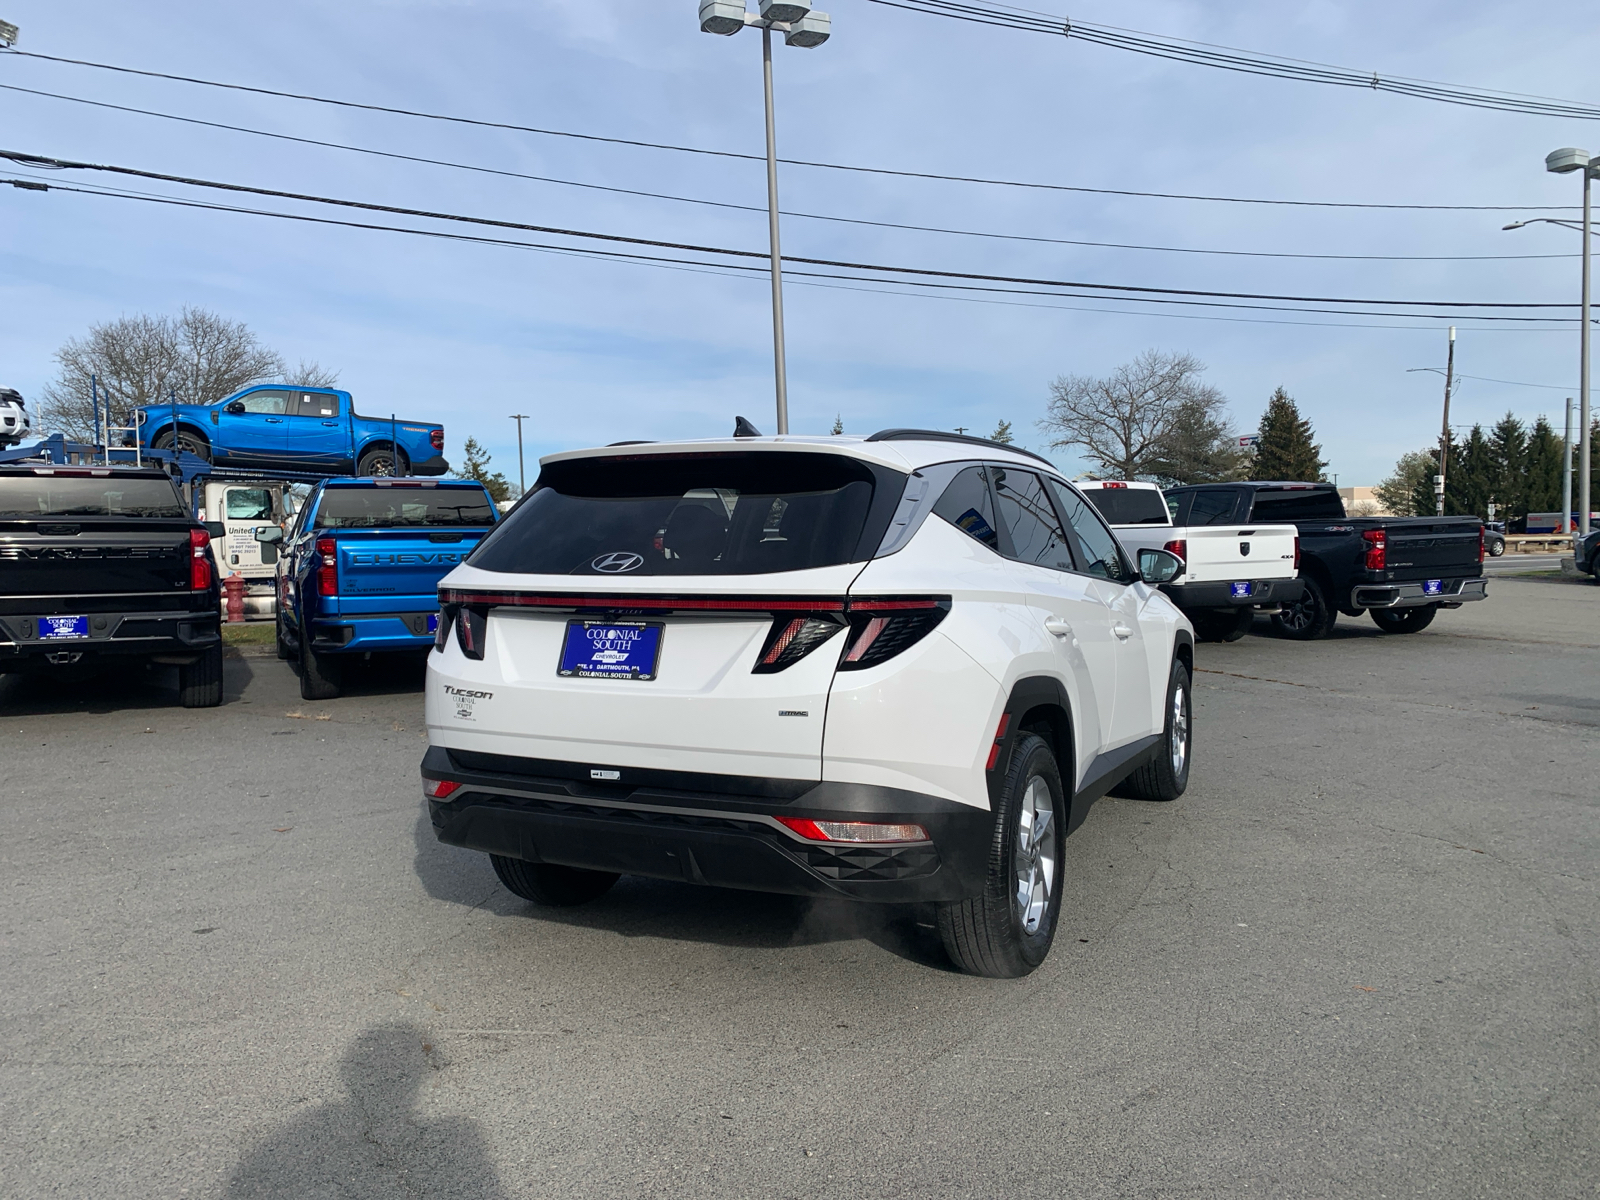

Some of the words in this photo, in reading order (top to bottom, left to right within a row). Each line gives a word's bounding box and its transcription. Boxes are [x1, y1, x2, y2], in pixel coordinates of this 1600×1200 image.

[586, 628, 642, 641] COLONIAL
[592, 639, 632, 650] SOUTH
[452, 696, 477, 705] COLONIAL
[455, 702, 473, 710] SOUTH
